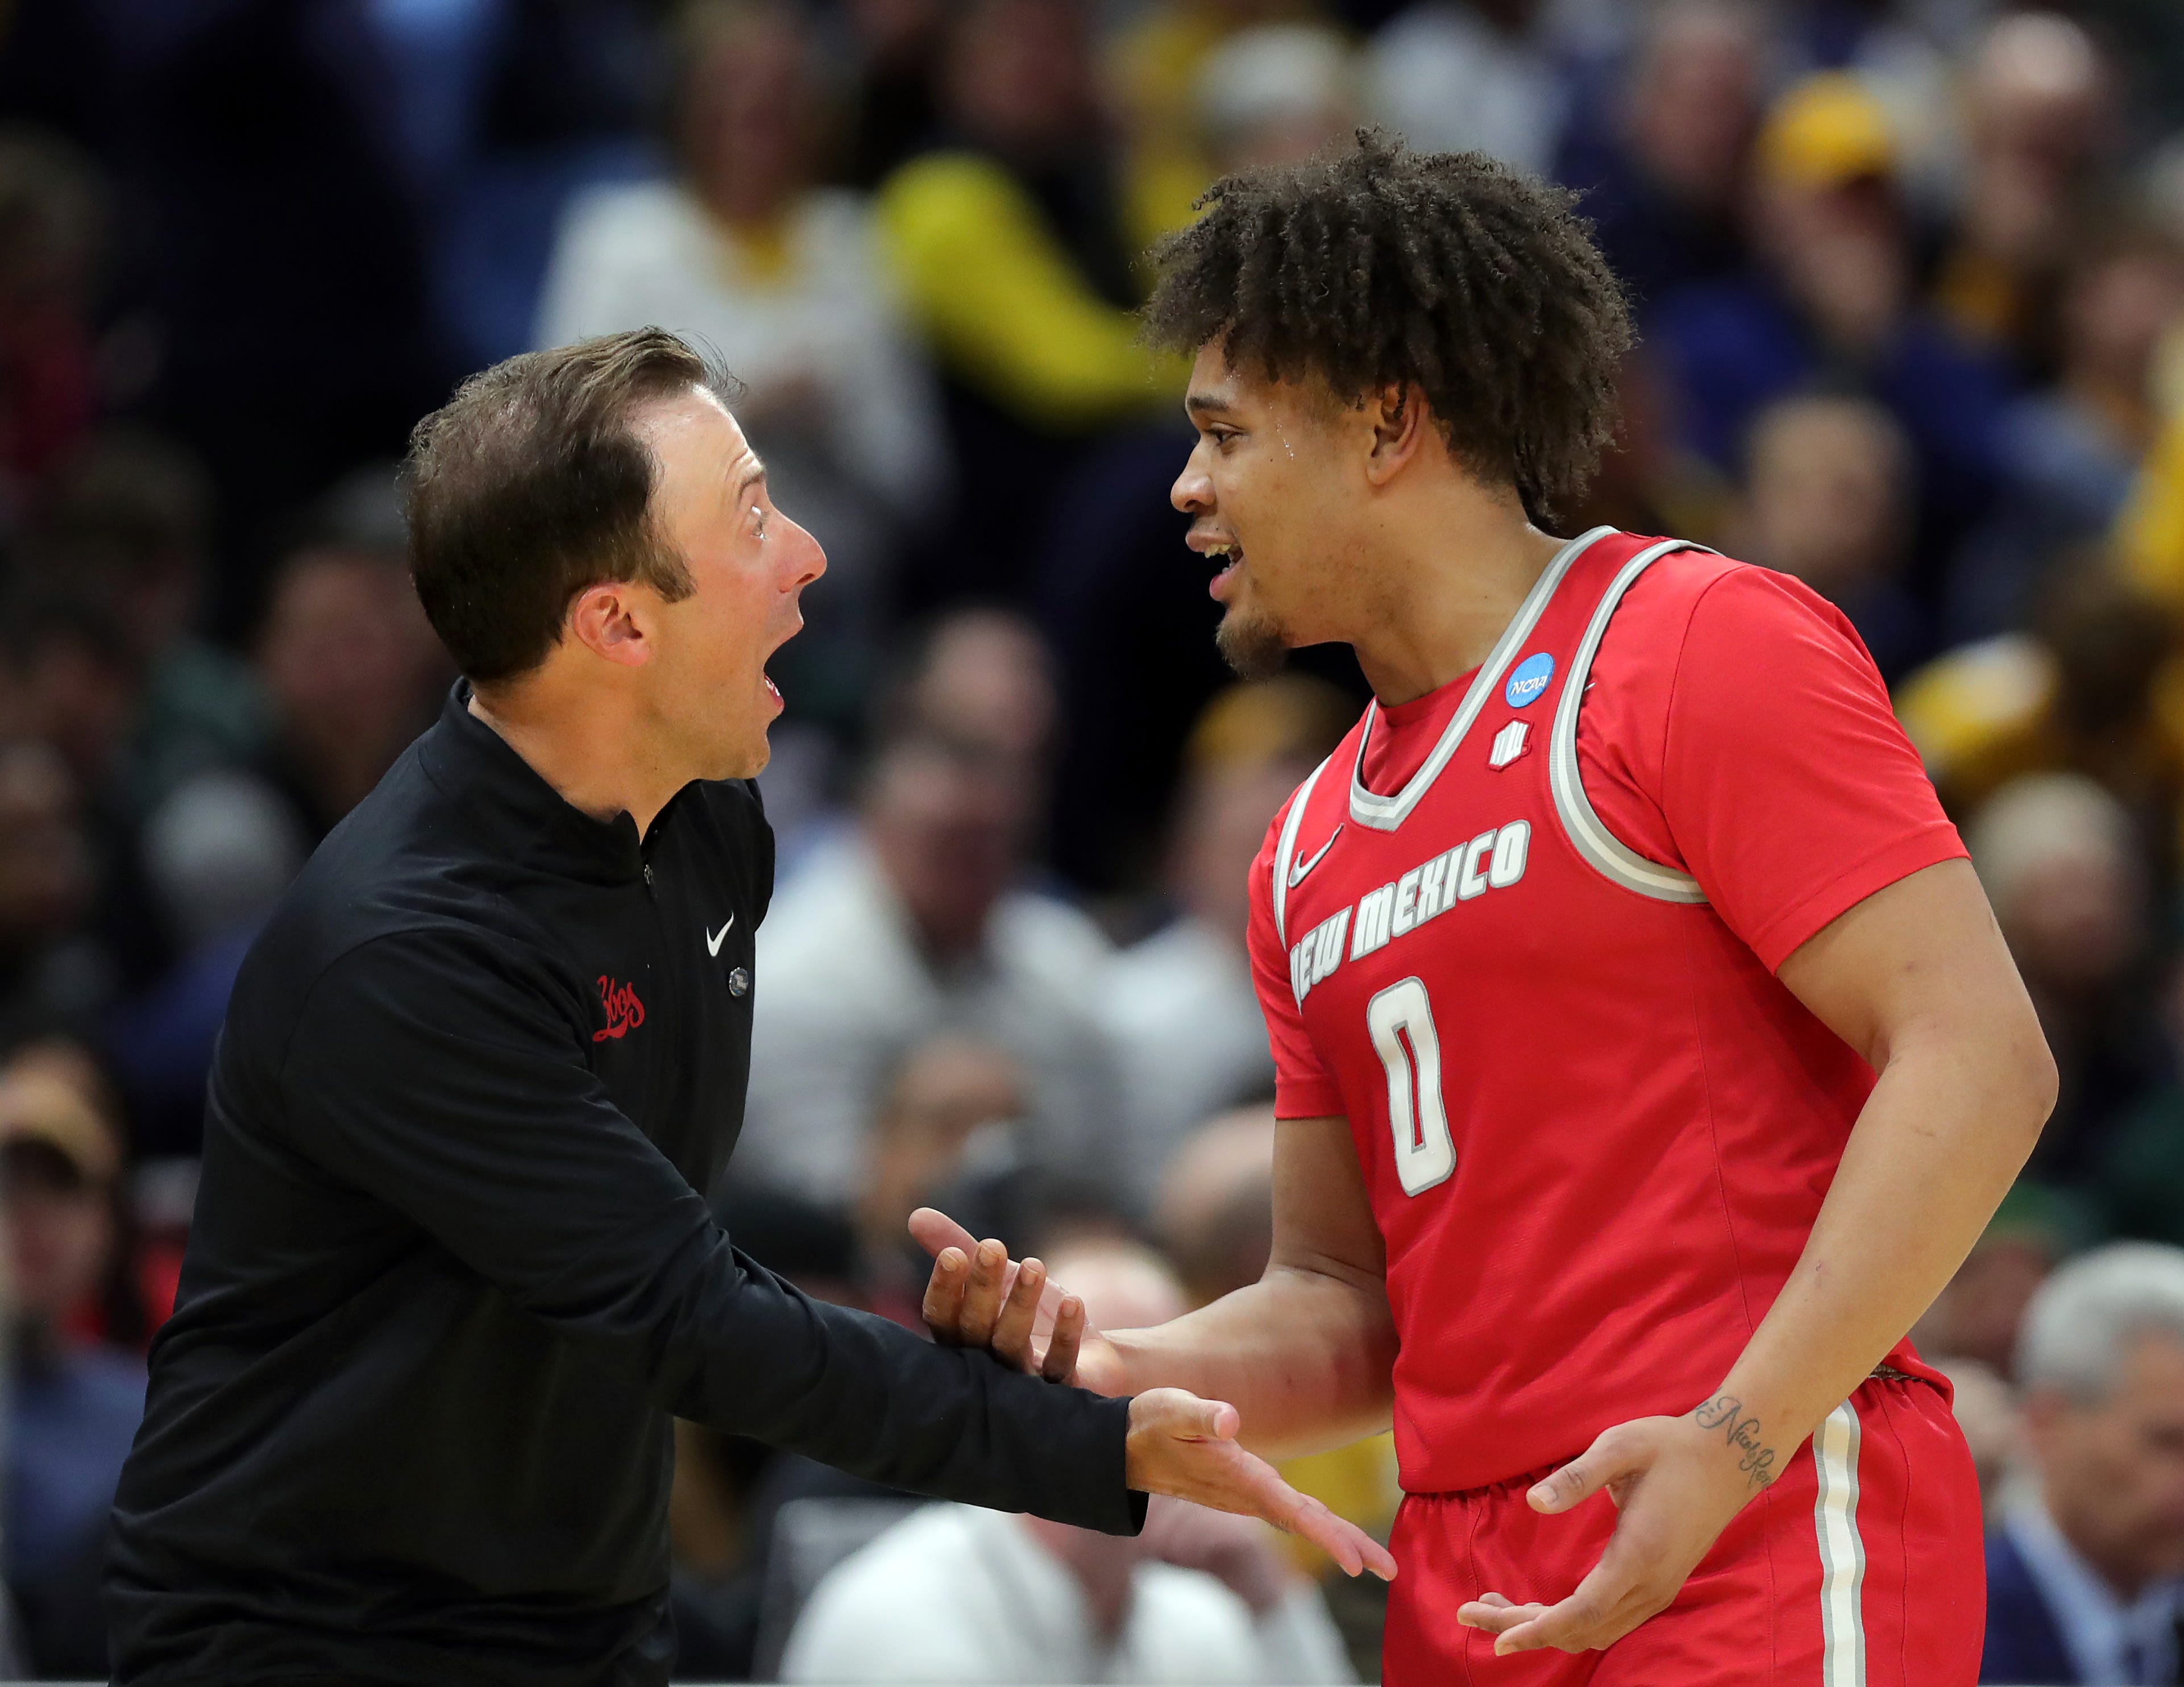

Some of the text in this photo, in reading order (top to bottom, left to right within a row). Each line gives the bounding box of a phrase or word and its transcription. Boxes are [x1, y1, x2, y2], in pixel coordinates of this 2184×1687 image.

[1510, 675, 1548, 696] NCAA
[1350, 819, 1531, 962] MEXICO
[1367, 975, 1456, 1197] 0
